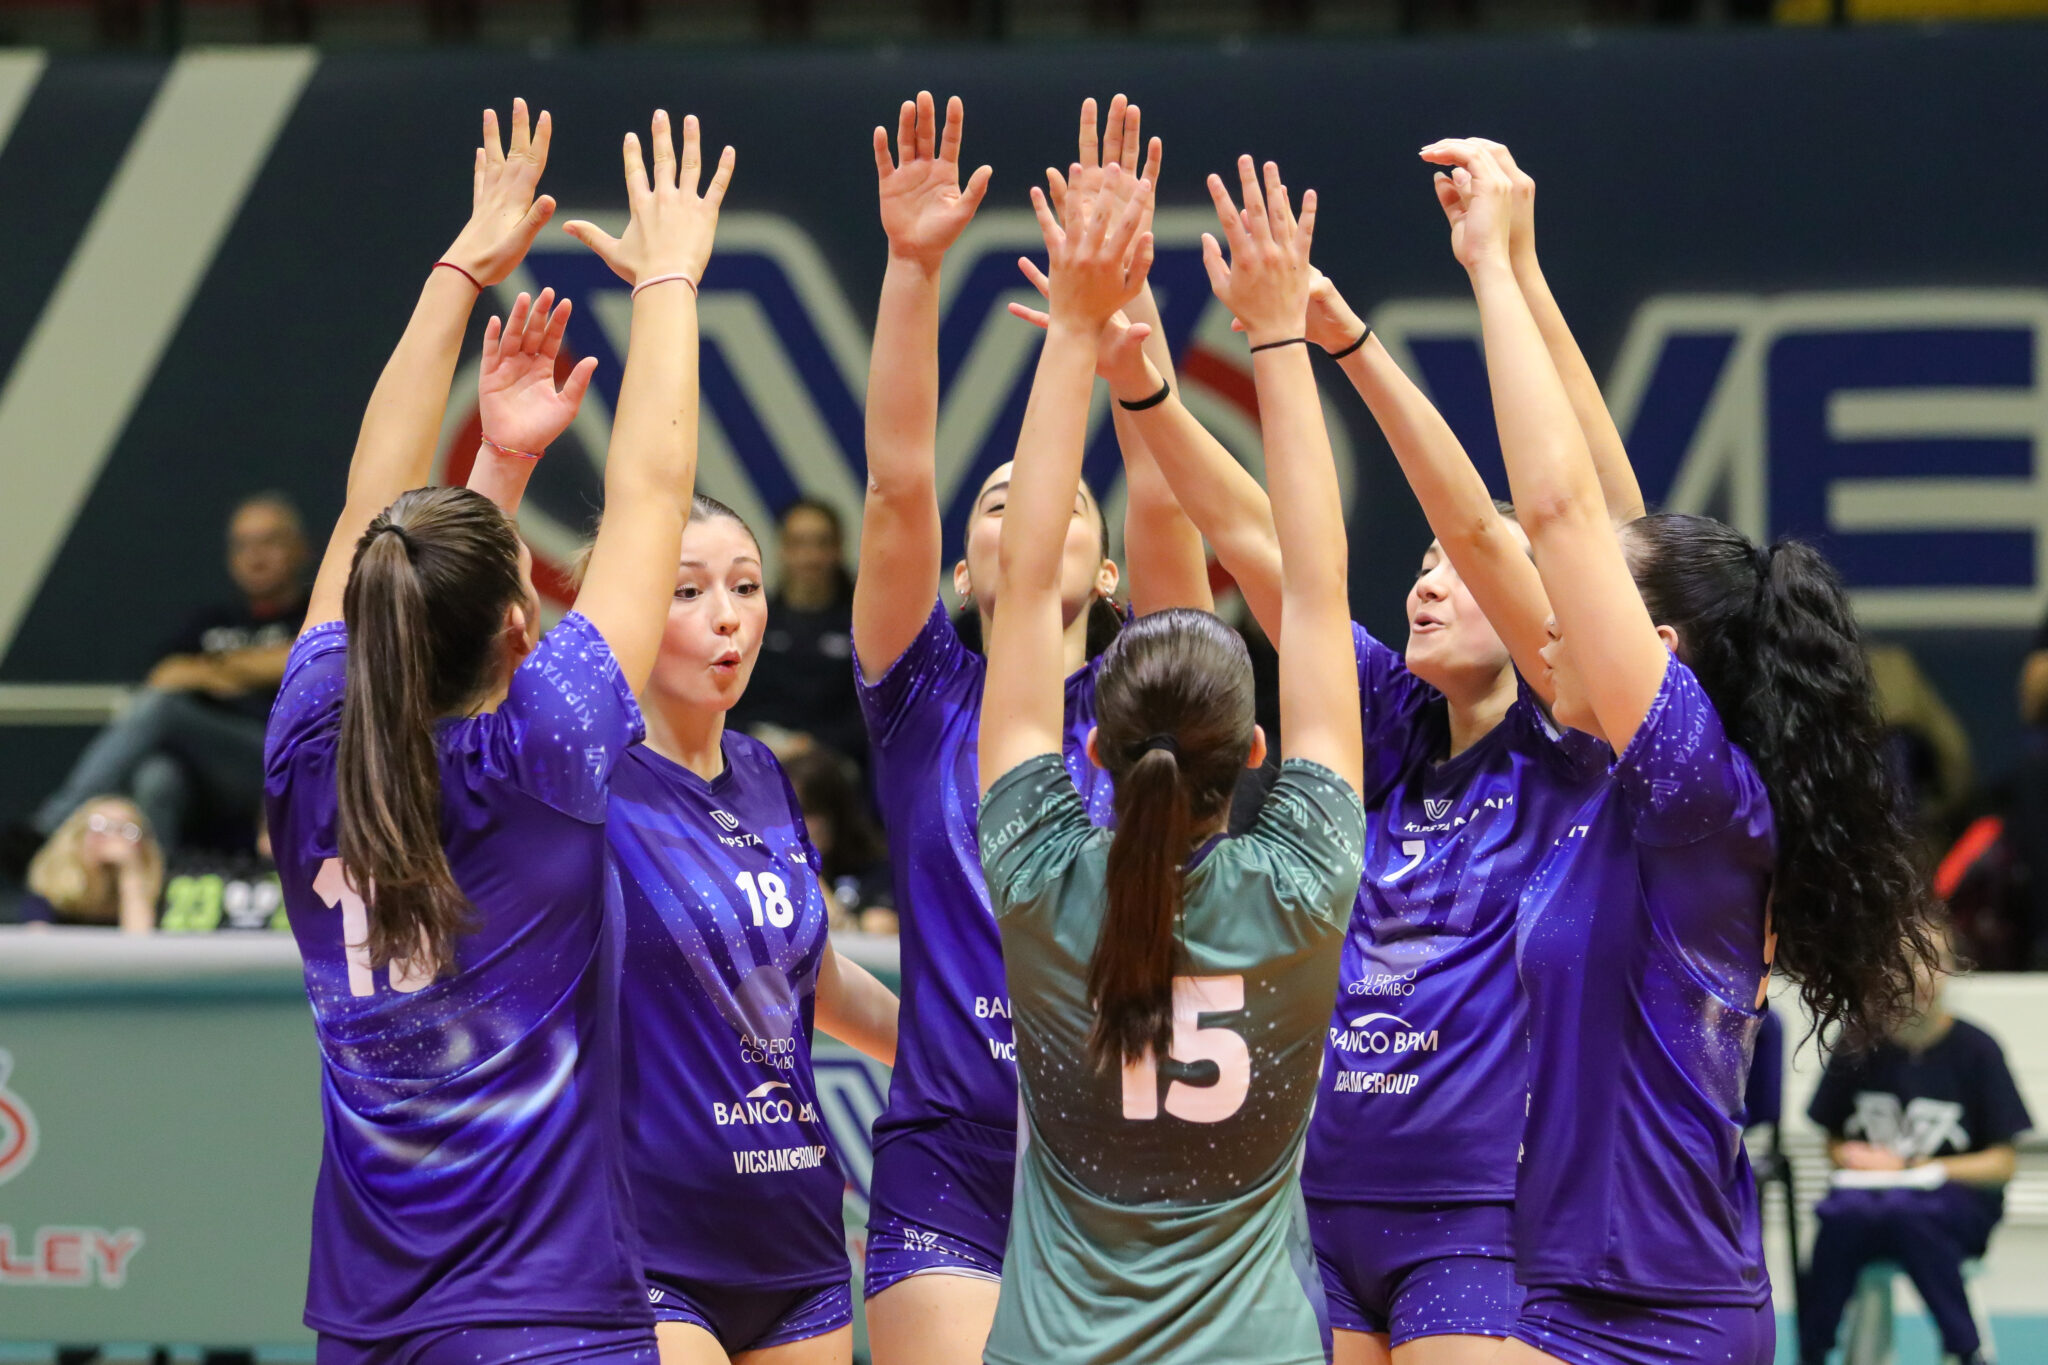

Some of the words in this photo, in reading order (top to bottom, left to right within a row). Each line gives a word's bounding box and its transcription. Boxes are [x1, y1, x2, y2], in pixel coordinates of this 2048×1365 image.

[542, 660, 594, 731] KIPSTA
[1673, 702, 1709, 764] KIPSTA
[980, 815, 1028, 868] KIPST
[1323, 821, 1363, 873] IPSTA
[1382, 839, 1426, 882] 7
[735, 871, 795, 928] 18
[312, 857, 442, 997] 1
[1347, 982, 1415, 996] COLOMBO
[1393, 1030, 1439, 1054] BPM
[712, 1099, 794, 1126] BANCO
[733, 1145, 827, 1174] VICSAMGROUP
